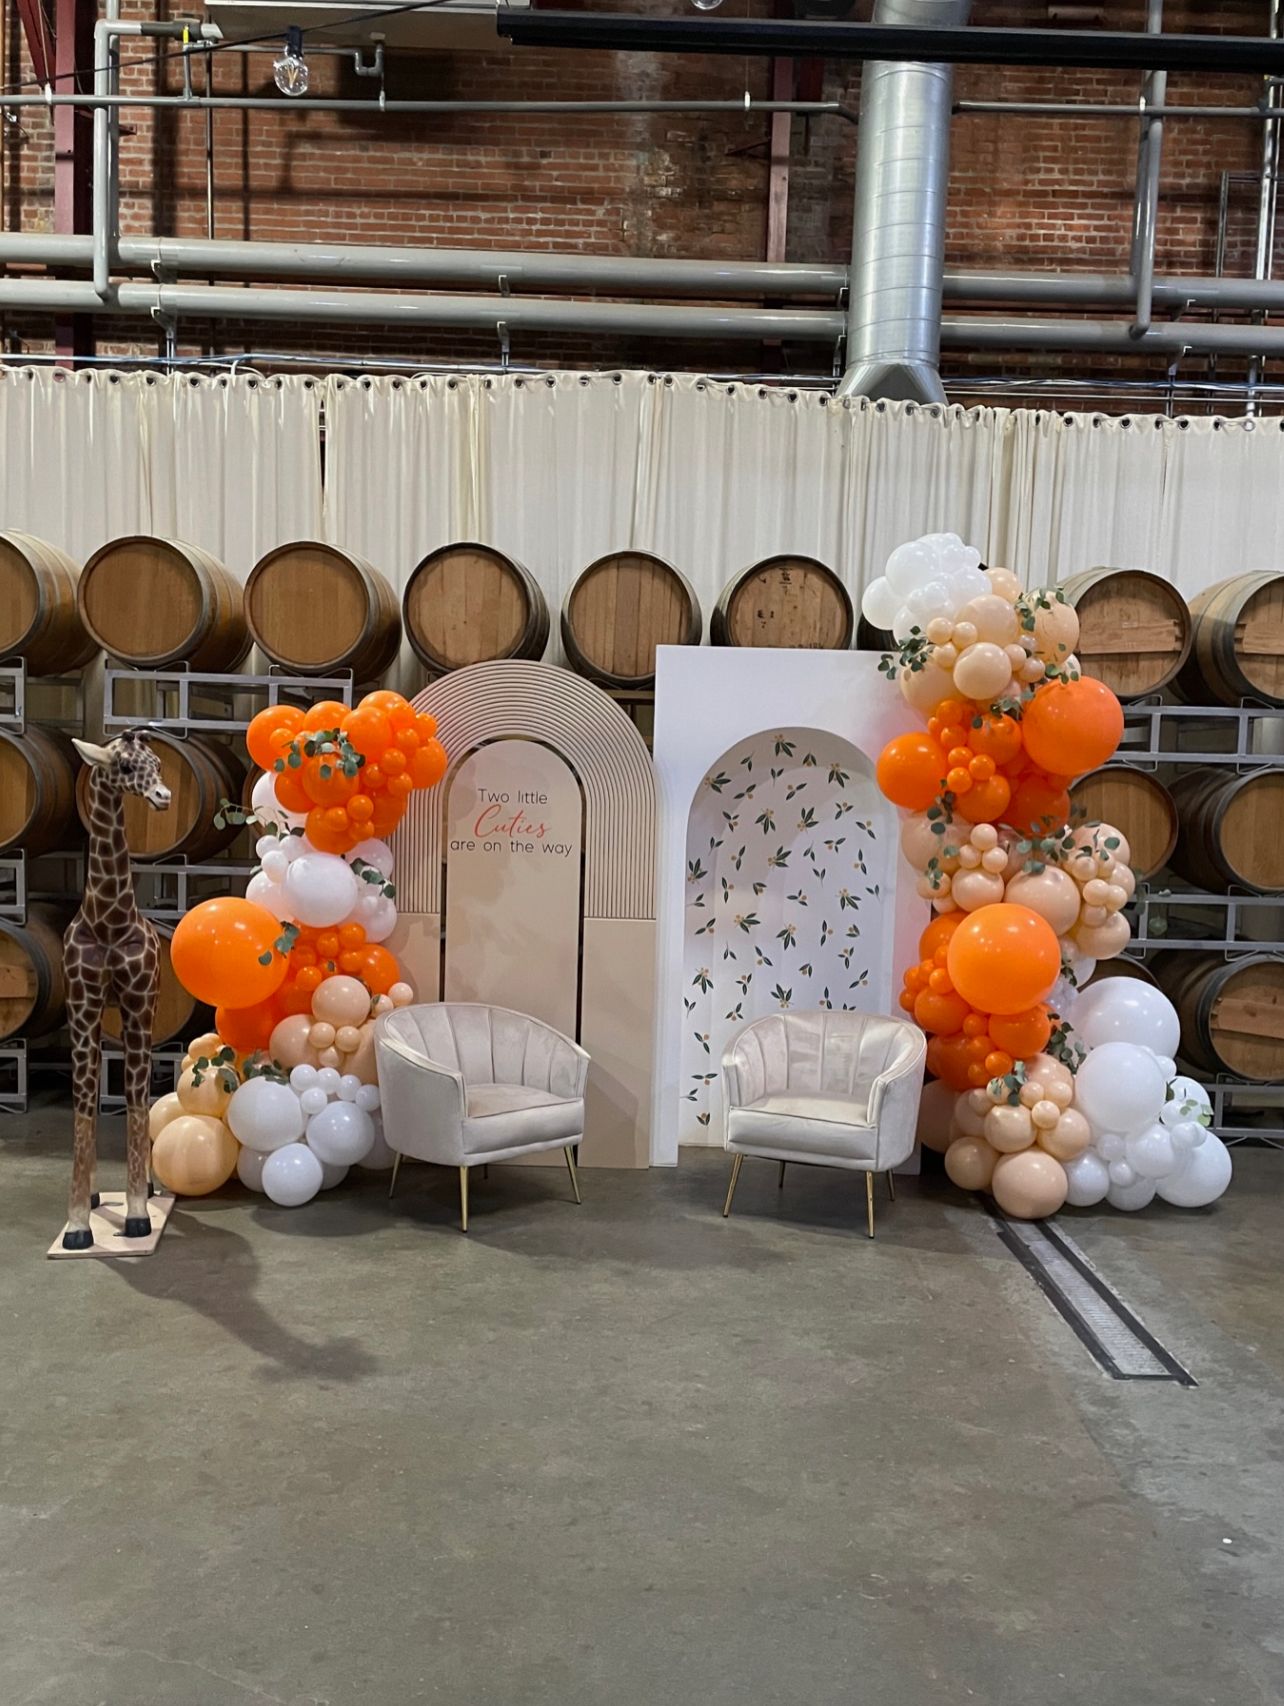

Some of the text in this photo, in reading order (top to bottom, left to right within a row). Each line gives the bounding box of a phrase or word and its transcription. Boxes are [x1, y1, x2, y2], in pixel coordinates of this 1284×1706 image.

[478, 788, 548, 805] Two little
[474, 804, 551, 838] Cuties
[450, 840, 573, 858] are on the way
